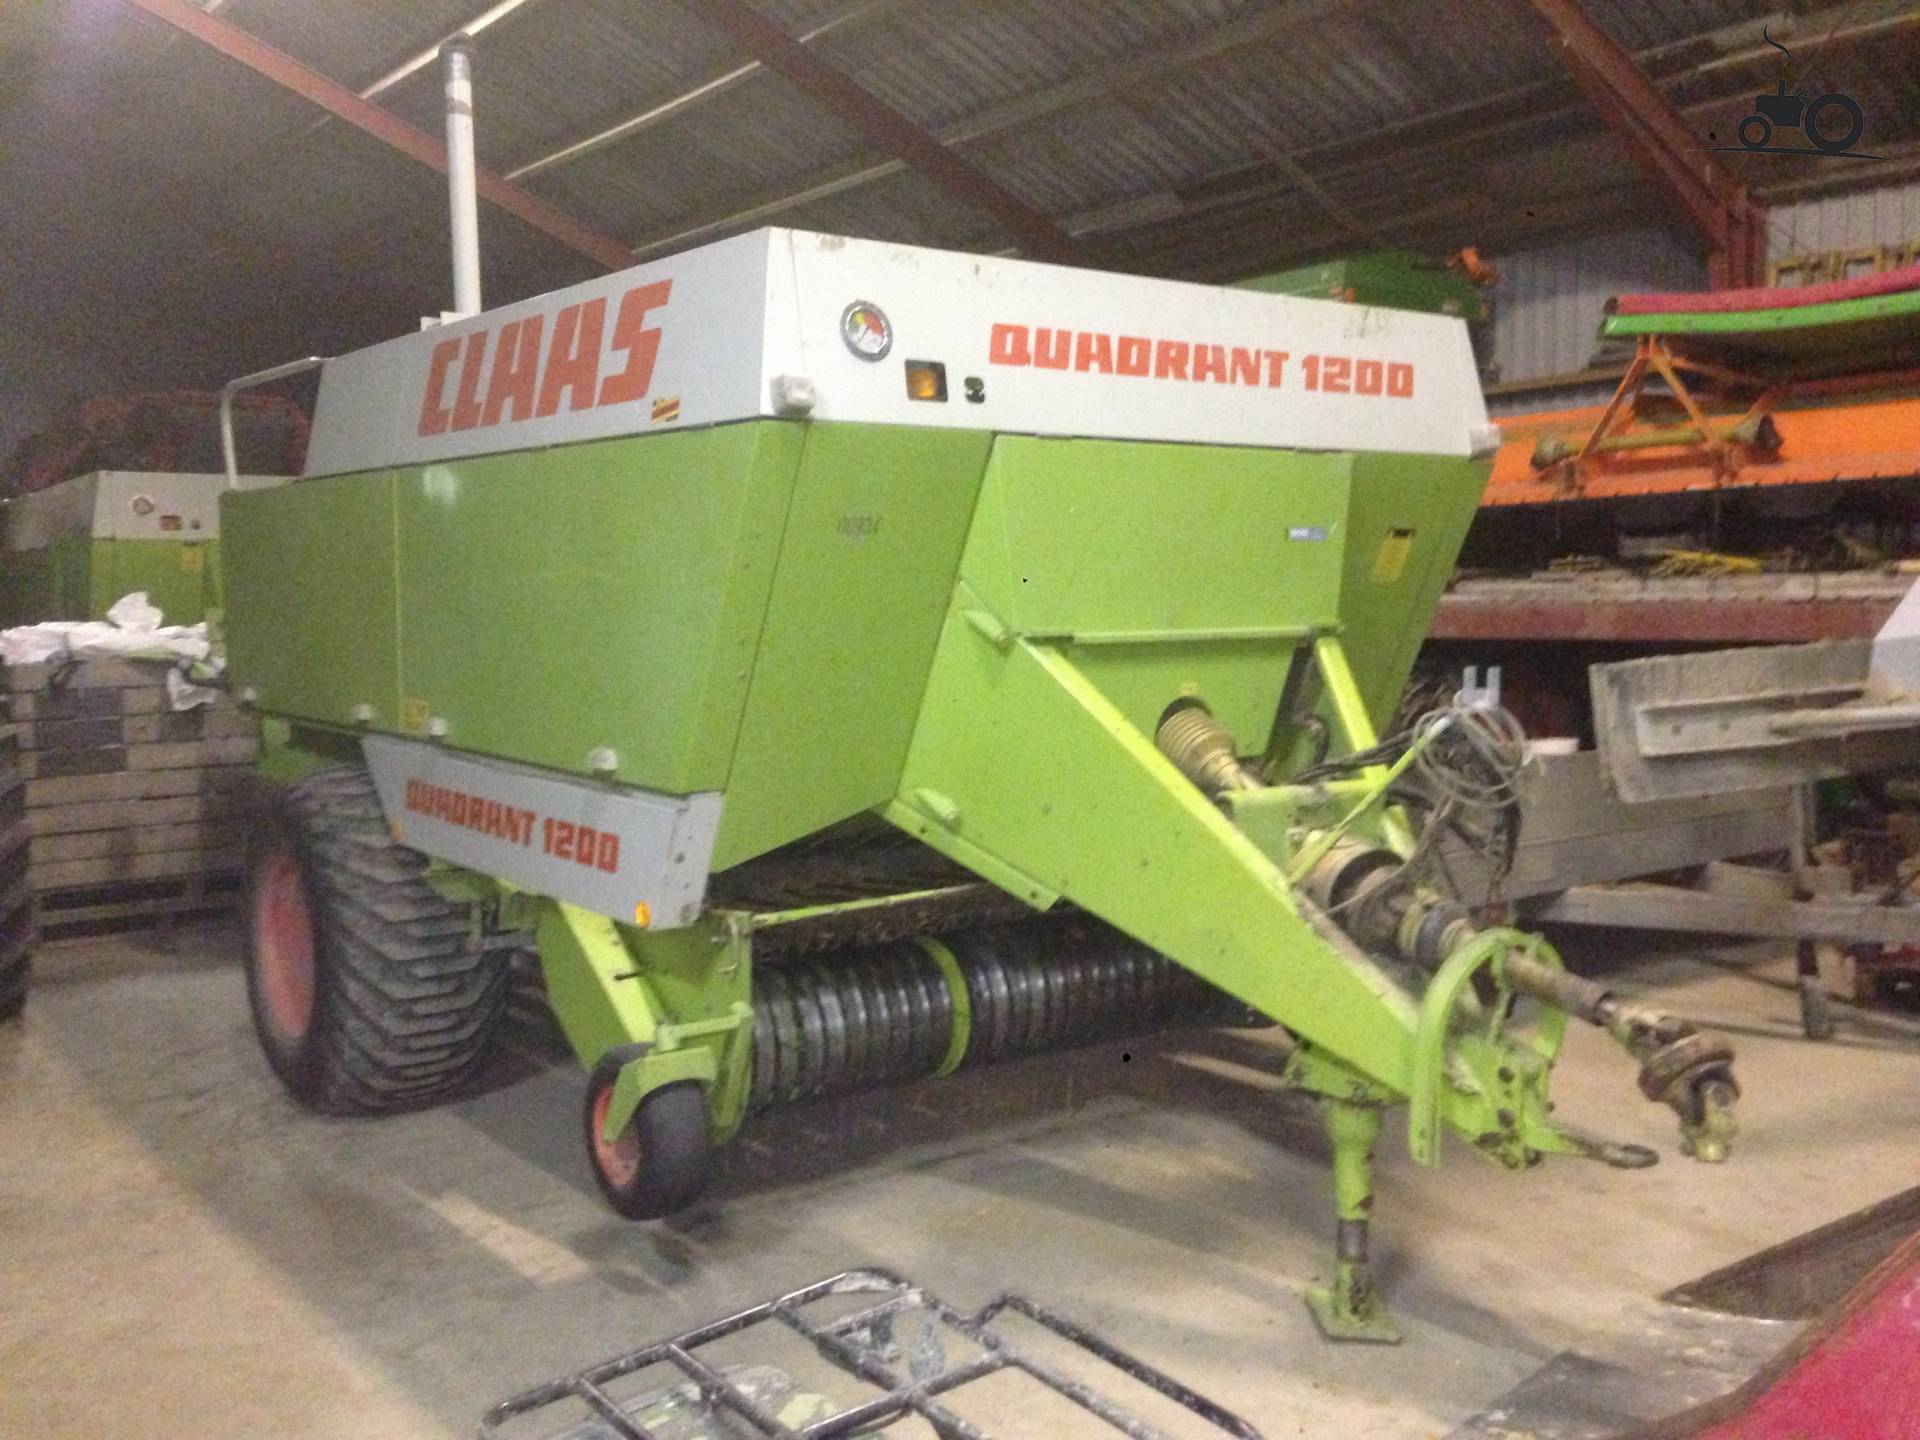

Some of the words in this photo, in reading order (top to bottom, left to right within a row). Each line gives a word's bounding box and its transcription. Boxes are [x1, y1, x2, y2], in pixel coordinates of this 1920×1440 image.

[417, 278, 673, 437] CLAAS
[989, 323, 1289, 388] QUADRANT
[1302, 353, 1414, 399] 1200
[406, 779, 536, 847] QUADRANT
[543, 817, 620, 873] 1200
